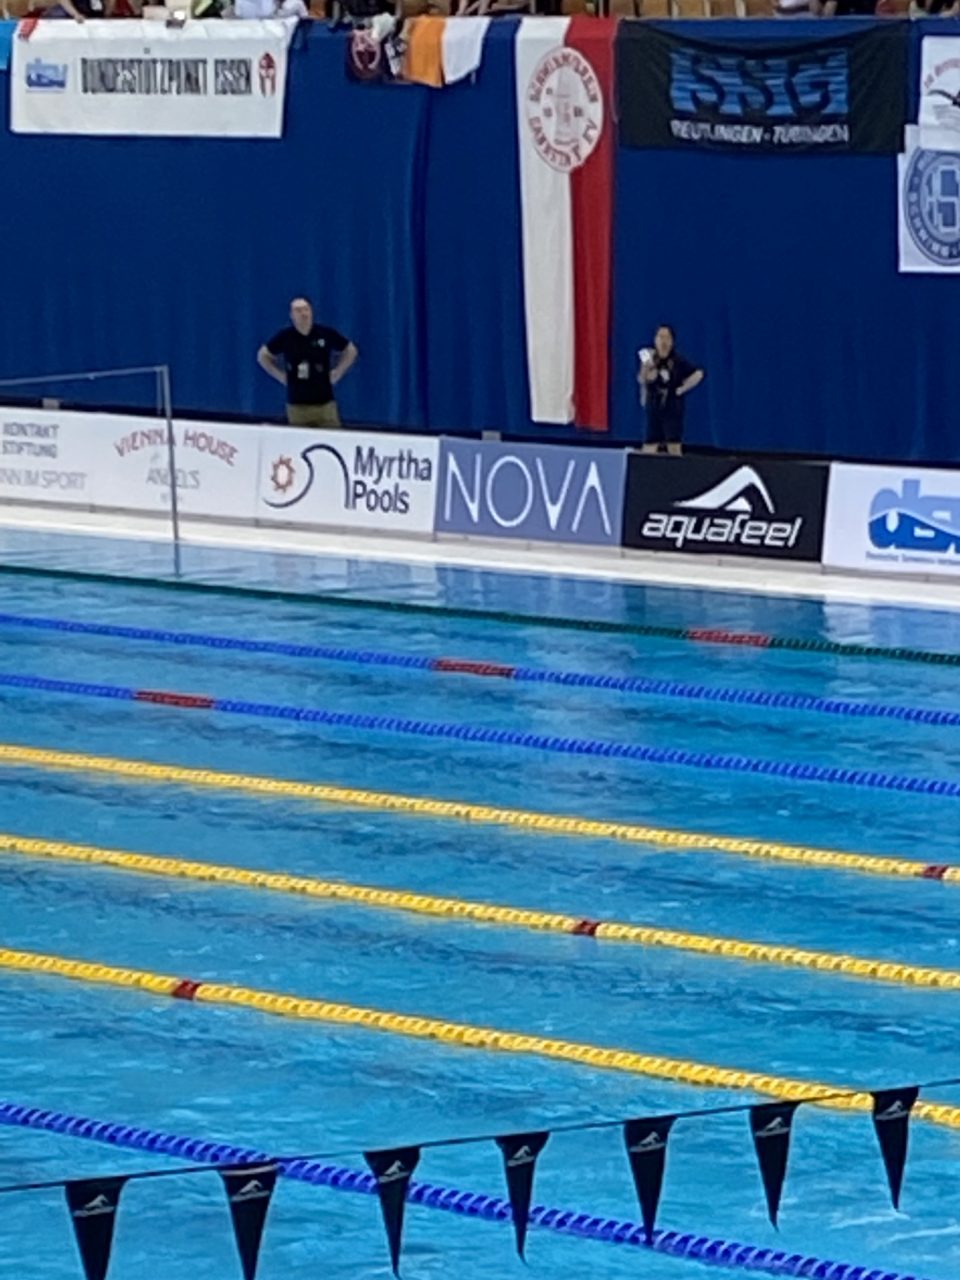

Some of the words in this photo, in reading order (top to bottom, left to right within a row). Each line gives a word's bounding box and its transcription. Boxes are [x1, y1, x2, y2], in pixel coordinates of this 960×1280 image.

[182, 429, 238, 467] HOUSE
[354, 445, 432, 483] Myrtha
[41, 469, 88, 491] SPORT
[352, 480, 410, 514] Pools
[444, 452, 612, 537] NOVA
[641, 511, 803, 548] aquafeel
